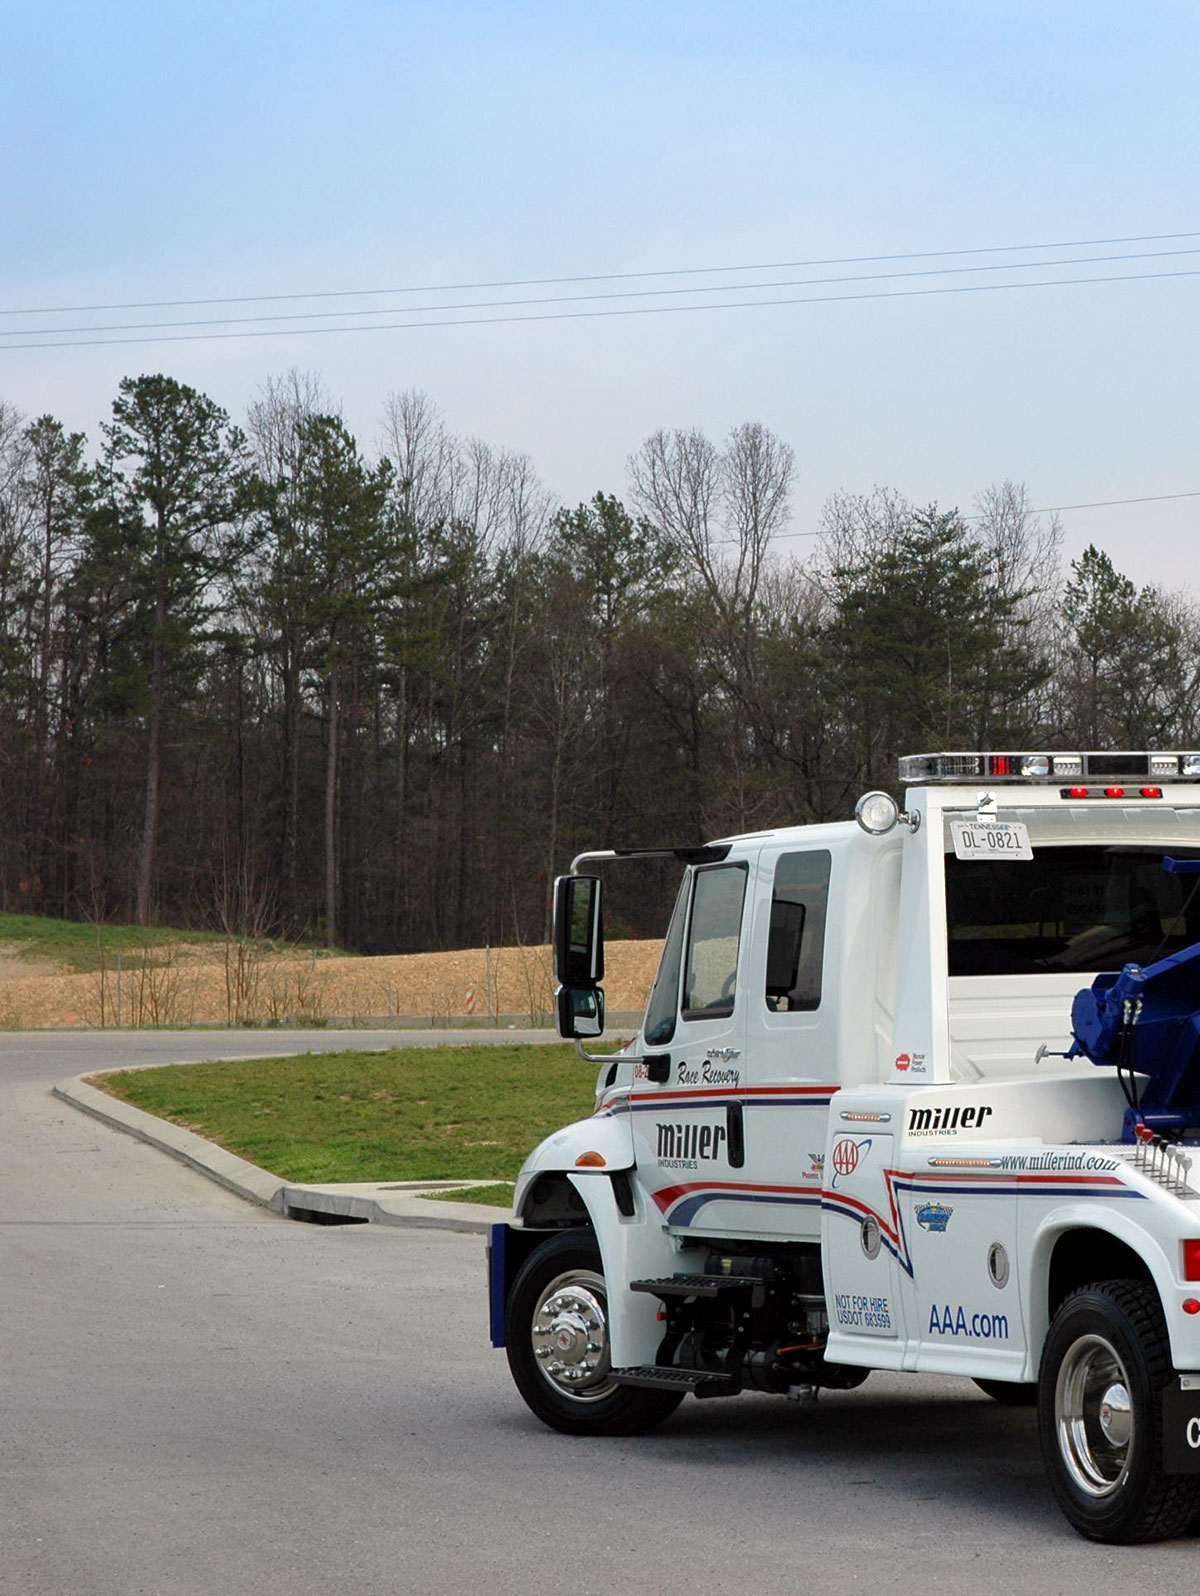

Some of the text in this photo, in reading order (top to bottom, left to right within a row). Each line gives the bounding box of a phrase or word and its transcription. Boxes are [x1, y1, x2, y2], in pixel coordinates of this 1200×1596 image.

[962, 831, 1022, 849] DL-0821
[635, 1064, 650, 1079] 08-2
[677, 1059, 740, 1089] Race Recovery
[908, 1106, 993, 1130] miller
[656, 1123, 726, 1160] miller
[908, 1129, 957, 1137] INDUSTRIES
[657, 1159, 698, 1170] INDUSTRIES
[833, 1139, 859, 1176] AAA
[1001, 1151, 1120, 1172] www.millerind.com
[835, 1294, 888, 1314] NOT FOR HIRE
[837, 1310, 863, 1325] USDOT
[929, 1304, 1009, 1339] AAA.com
